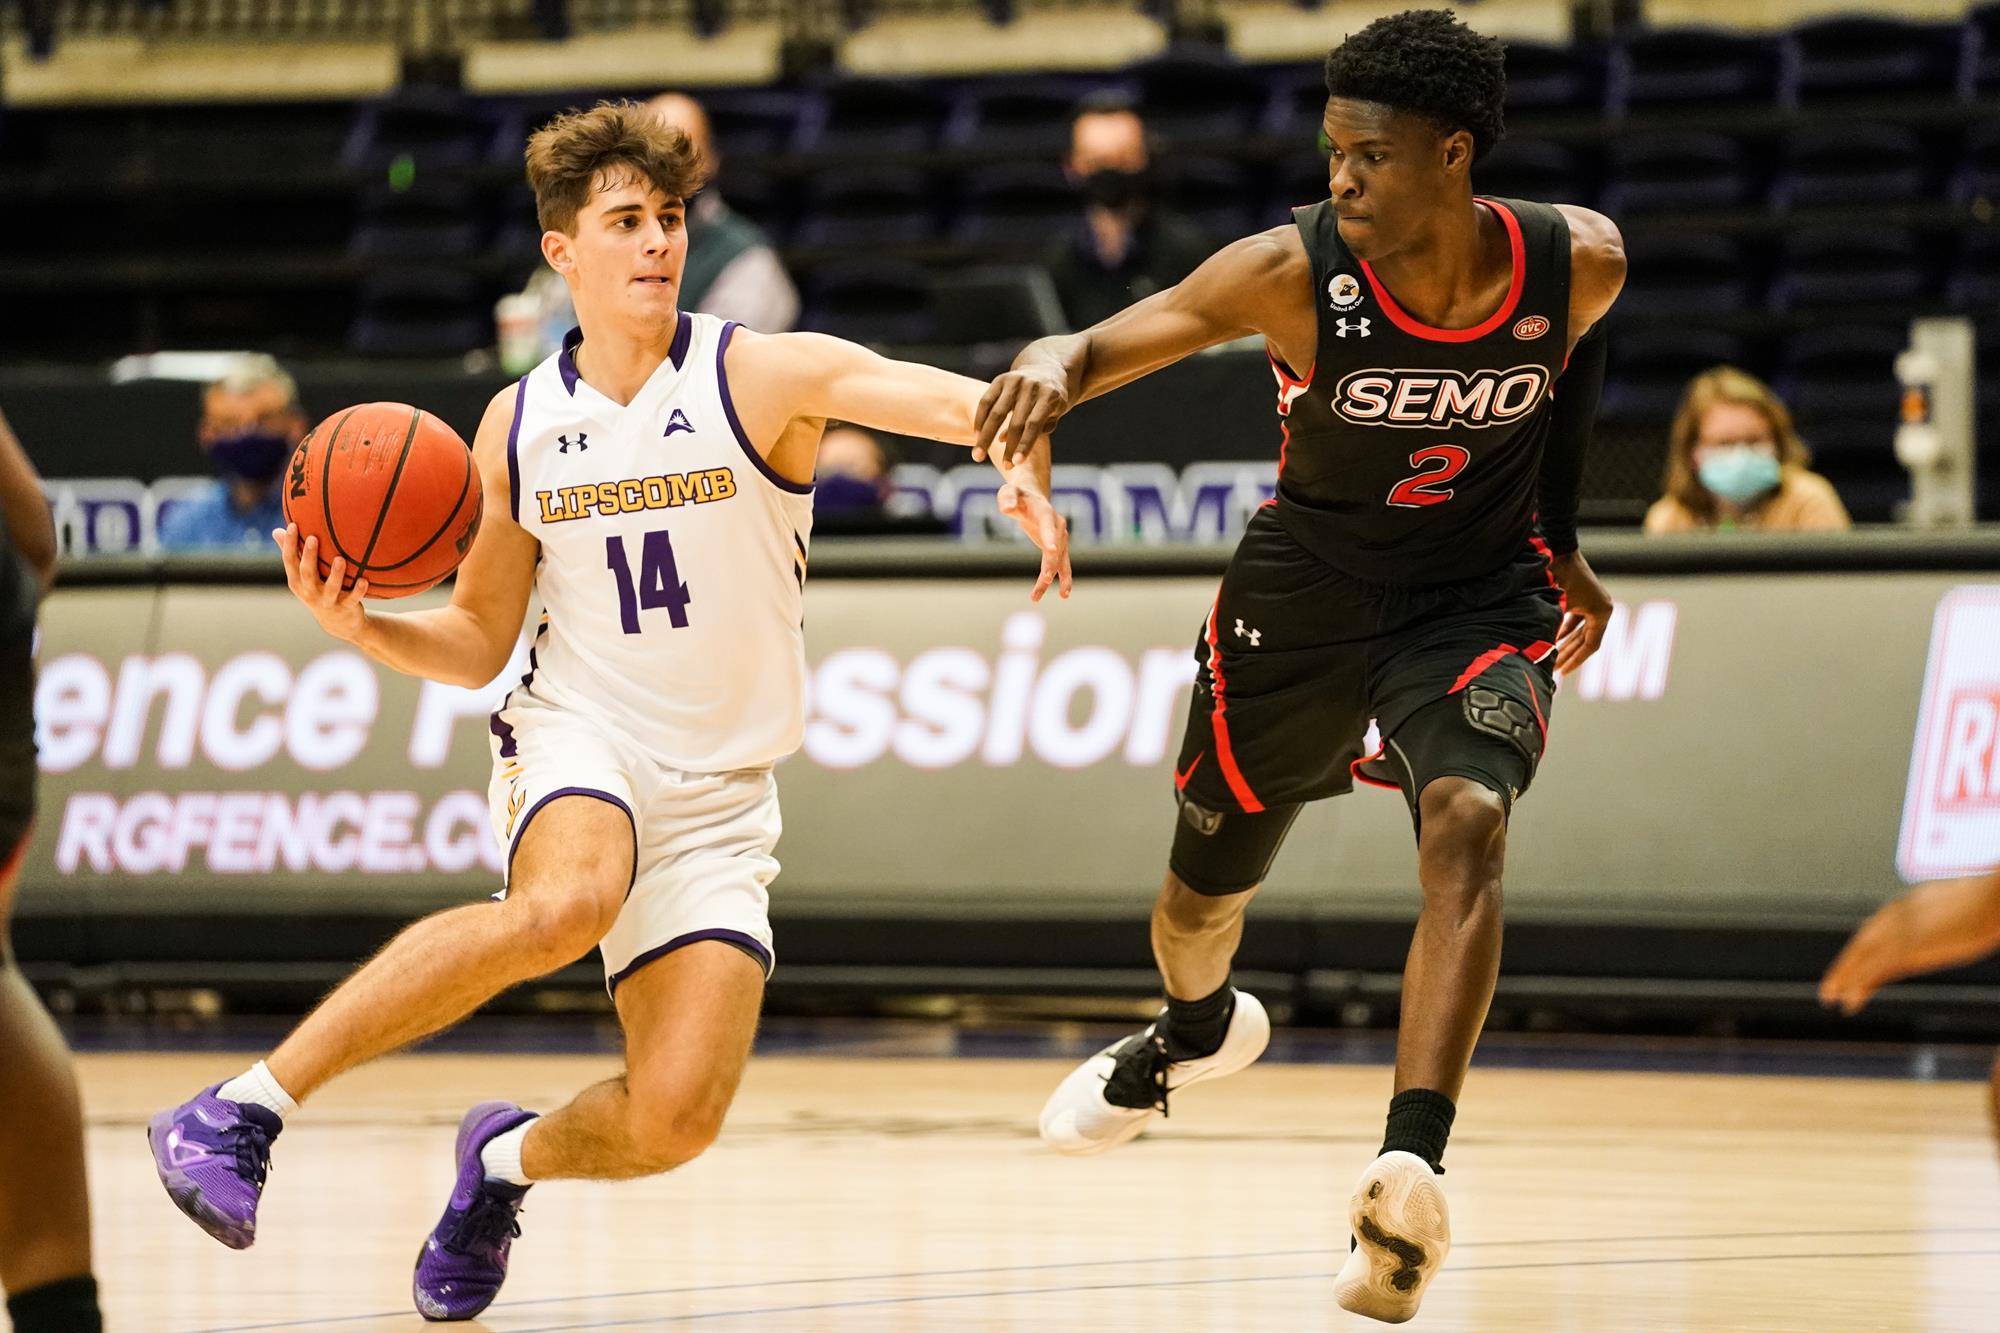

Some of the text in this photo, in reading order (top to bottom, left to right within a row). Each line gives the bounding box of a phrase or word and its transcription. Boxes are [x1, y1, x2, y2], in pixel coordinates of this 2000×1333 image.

[1330, 303, 1347, 312] United
[1520, 322, 1541, 334] OVC
[1333, 366, 1547, 428] SEMO
[536, 466, 737, 524] LIPSCOMB
[1386, 444, 1471, 508] 2
[606, 529, 691, 634] 14
[33, 652, 378, 772] ence
